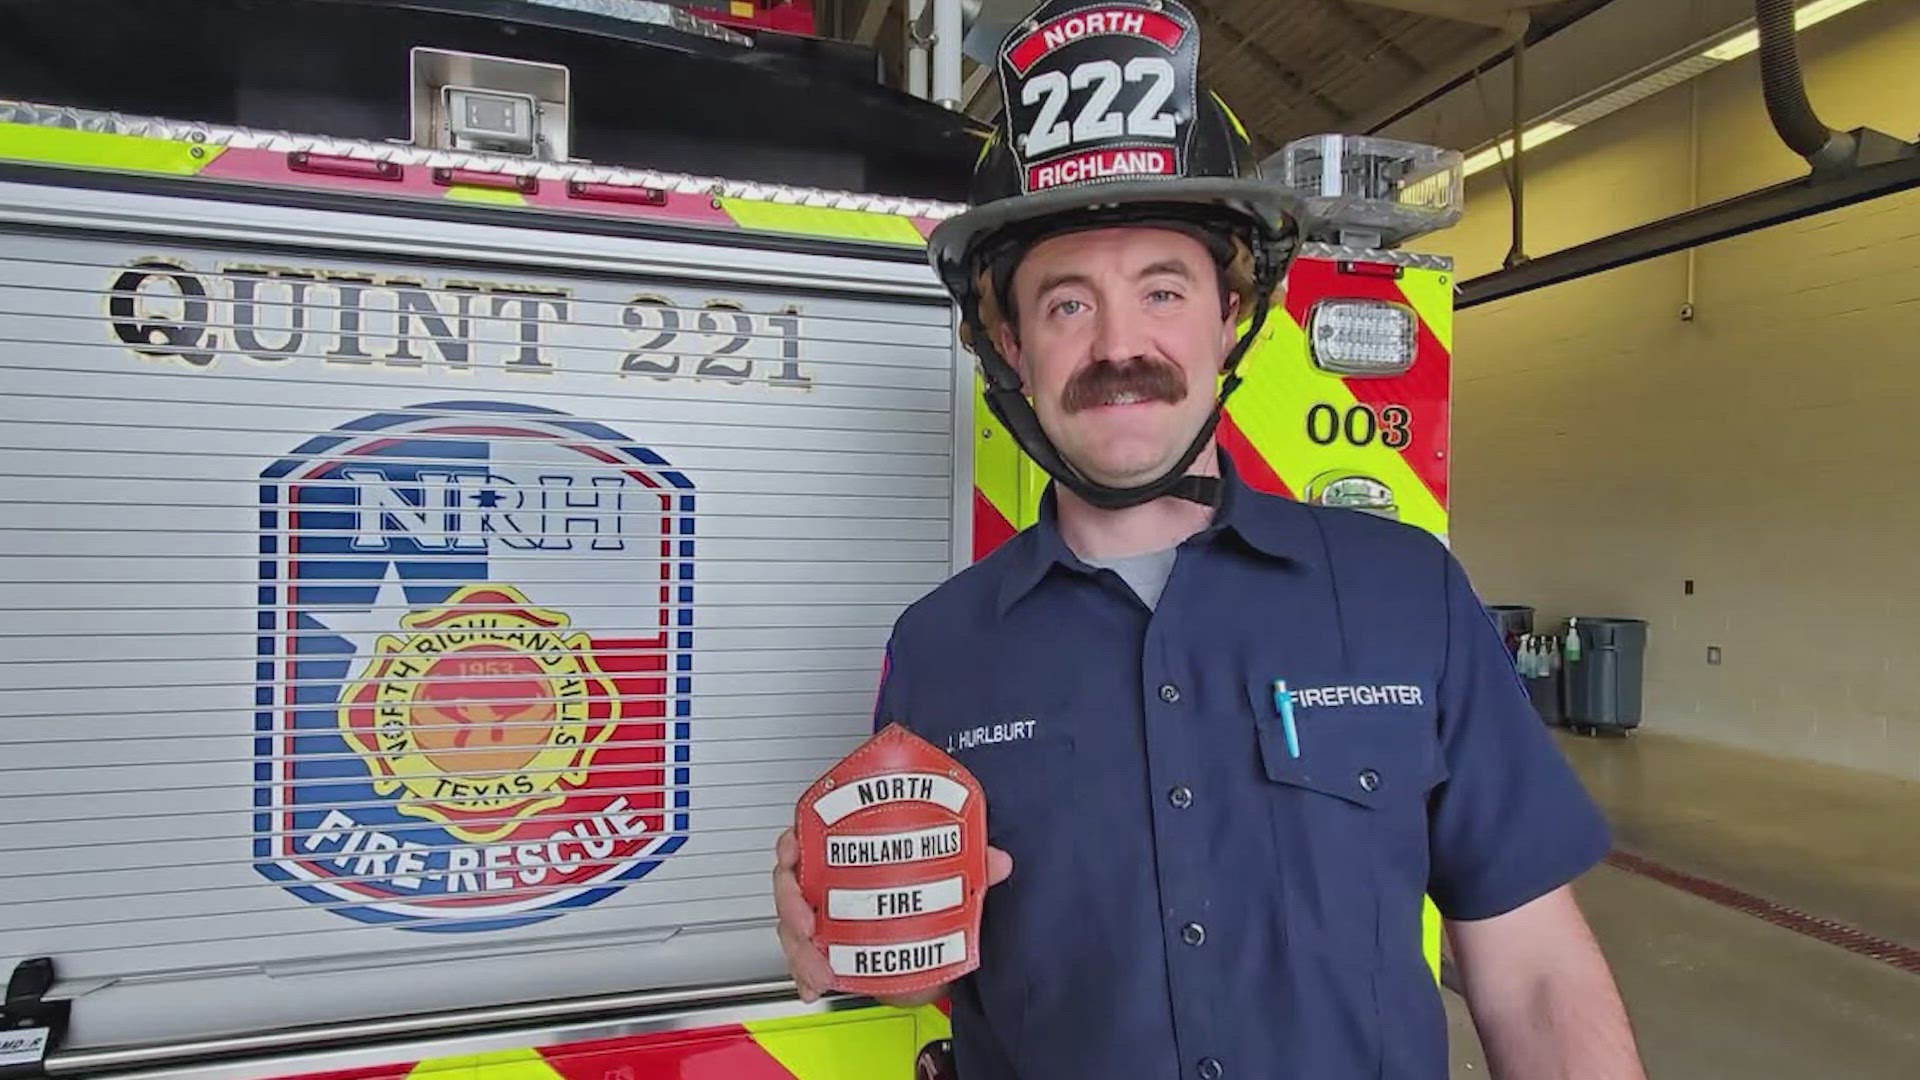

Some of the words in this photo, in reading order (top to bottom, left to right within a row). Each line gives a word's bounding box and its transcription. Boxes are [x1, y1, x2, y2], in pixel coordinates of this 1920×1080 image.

[1043, 12, 1144, 49] NORTH
[1021, 57, 1176, 157] 222
[1037, 152, 1164, 189] RICHLAND
[108, 257, 573, 373] QUINT
[620, 294, 813, 388] 221
[1307, 403, 1412, 449] 003
[343, 469, 624, 550] NRH
[381, 661, 420, 761] NORTH
[416, 619, 563, 666] RICHLAND
[555, 670, 584, 747] HILLS
[959, 720, 1037, 750] HURLBURT
[432, 775, 534, 806] TEXAS
[858, 777, 933, 805] NORTH
[304, 796, 647, 893] FIRE-RESCUE
[831, 838, 913, 864] RICHLAND
[920, 830, 958, 854] HILLS
[877, 890, 923, 915] FIRE
[855, 943, 945, 974] RECRUIT
